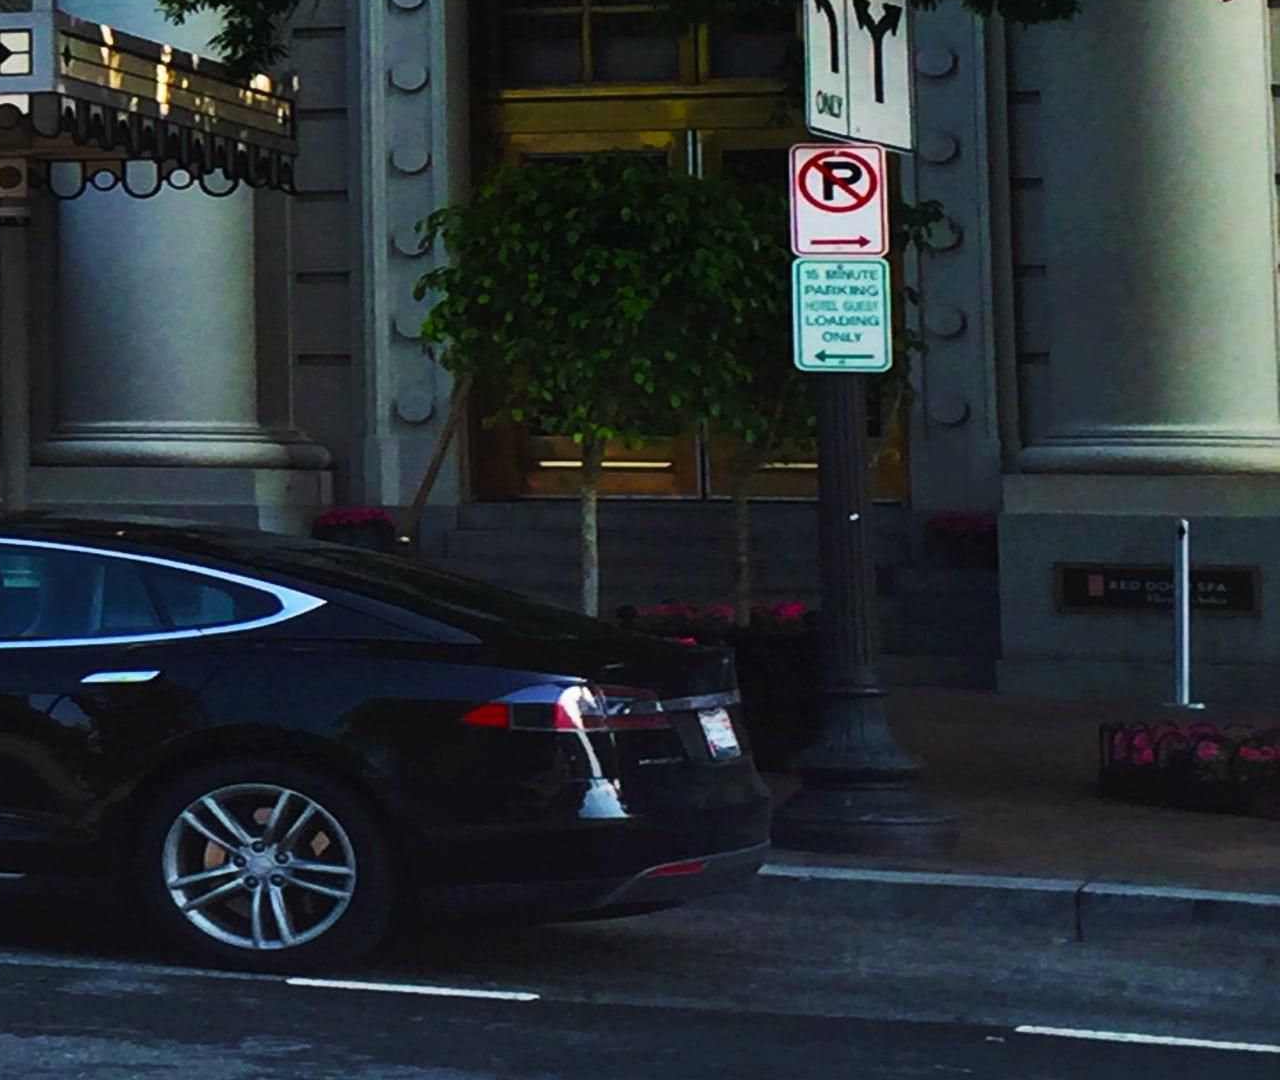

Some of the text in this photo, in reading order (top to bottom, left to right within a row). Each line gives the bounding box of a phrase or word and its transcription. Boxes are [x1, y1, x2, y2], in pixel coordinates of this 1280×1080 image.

[815, 90, 843, 118] ONLY
[822, 160, 862, 201] P
[825, 269, 878, 281] MINUTE
[804, 284, 880, 297] PARKING
[805, 300, 878, 312] HOTEL GUEST
[805, 314, 880, 327] LOADING
[821, 330, 863, 343] ONLY
[1108, 579, 1141, 592] RED
[1196, 581, 1229, 593] SPA
